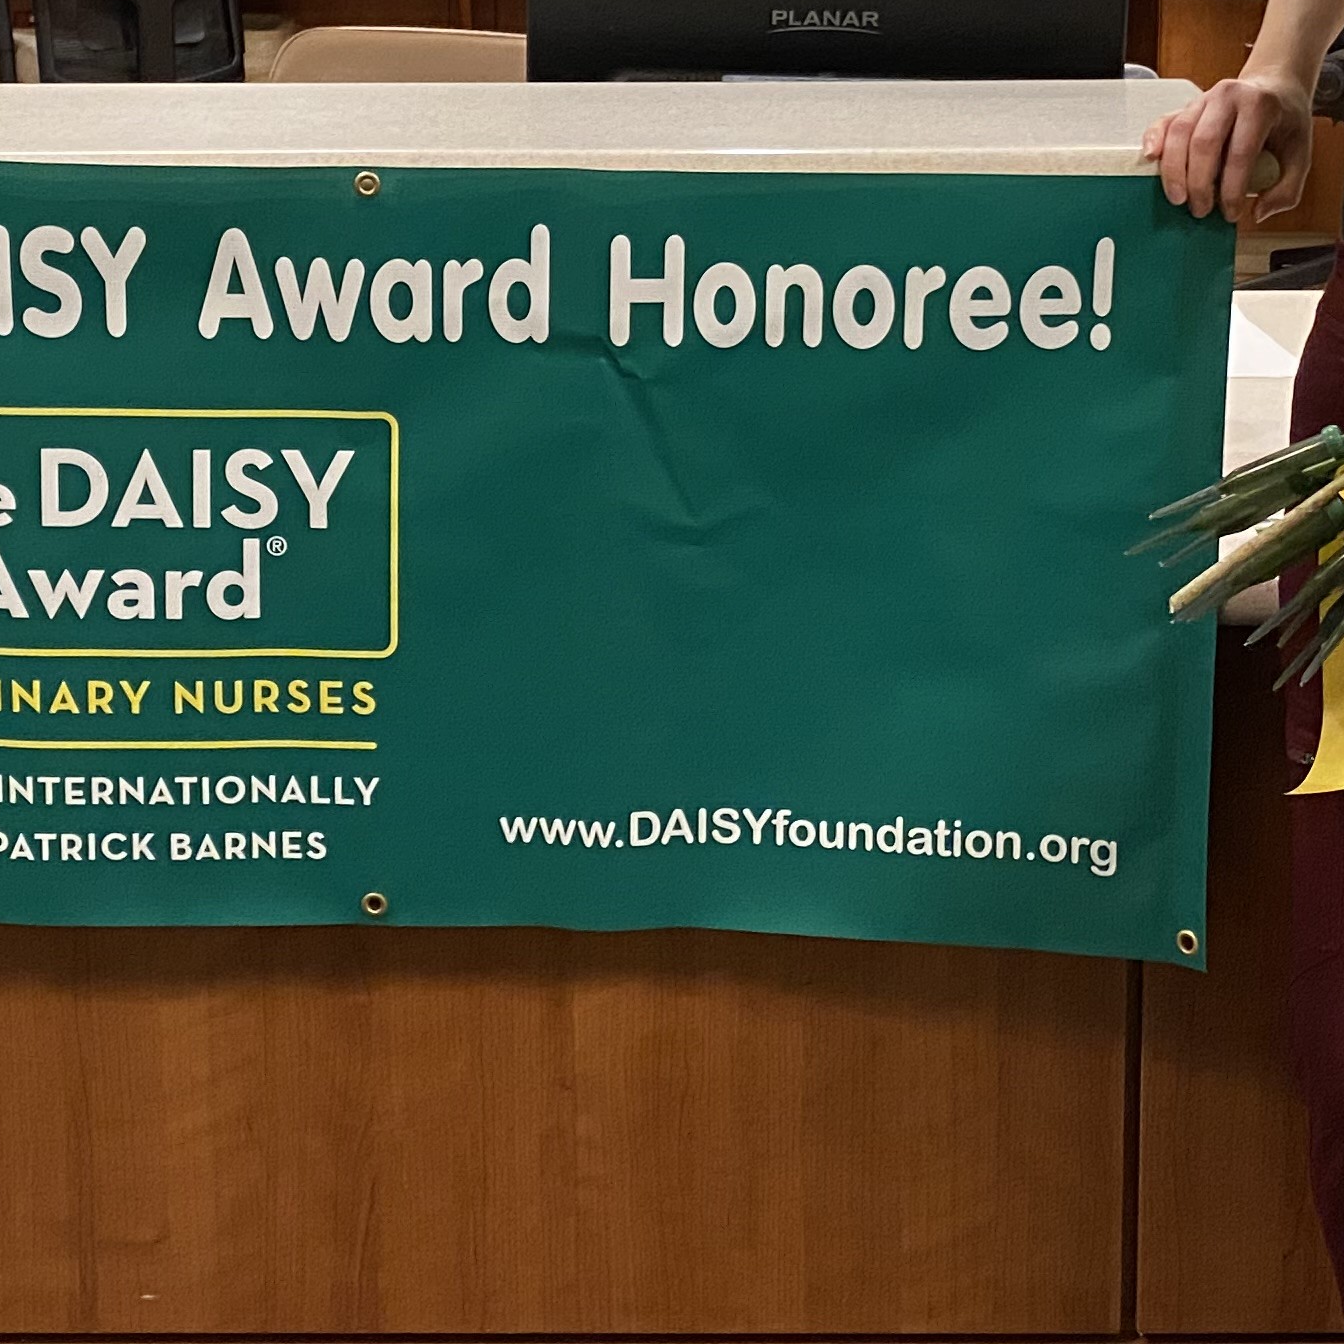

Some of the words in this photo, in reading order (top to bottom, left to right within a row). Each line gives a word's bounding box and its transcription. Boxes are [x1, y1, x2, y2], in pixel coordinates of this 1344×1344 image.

[771, 10, 879, 27] PLANAR
[199, 224, 550, 343] Award
[610, 235, 1115, 350] Honoree!
[41, 448, 355, 529] DAISY
[175, 680, 376, 714] NURSES
[171, 831, 326, 860] BARNES
[500, 808, 1117, 876] www.DAISYfoundation.org
